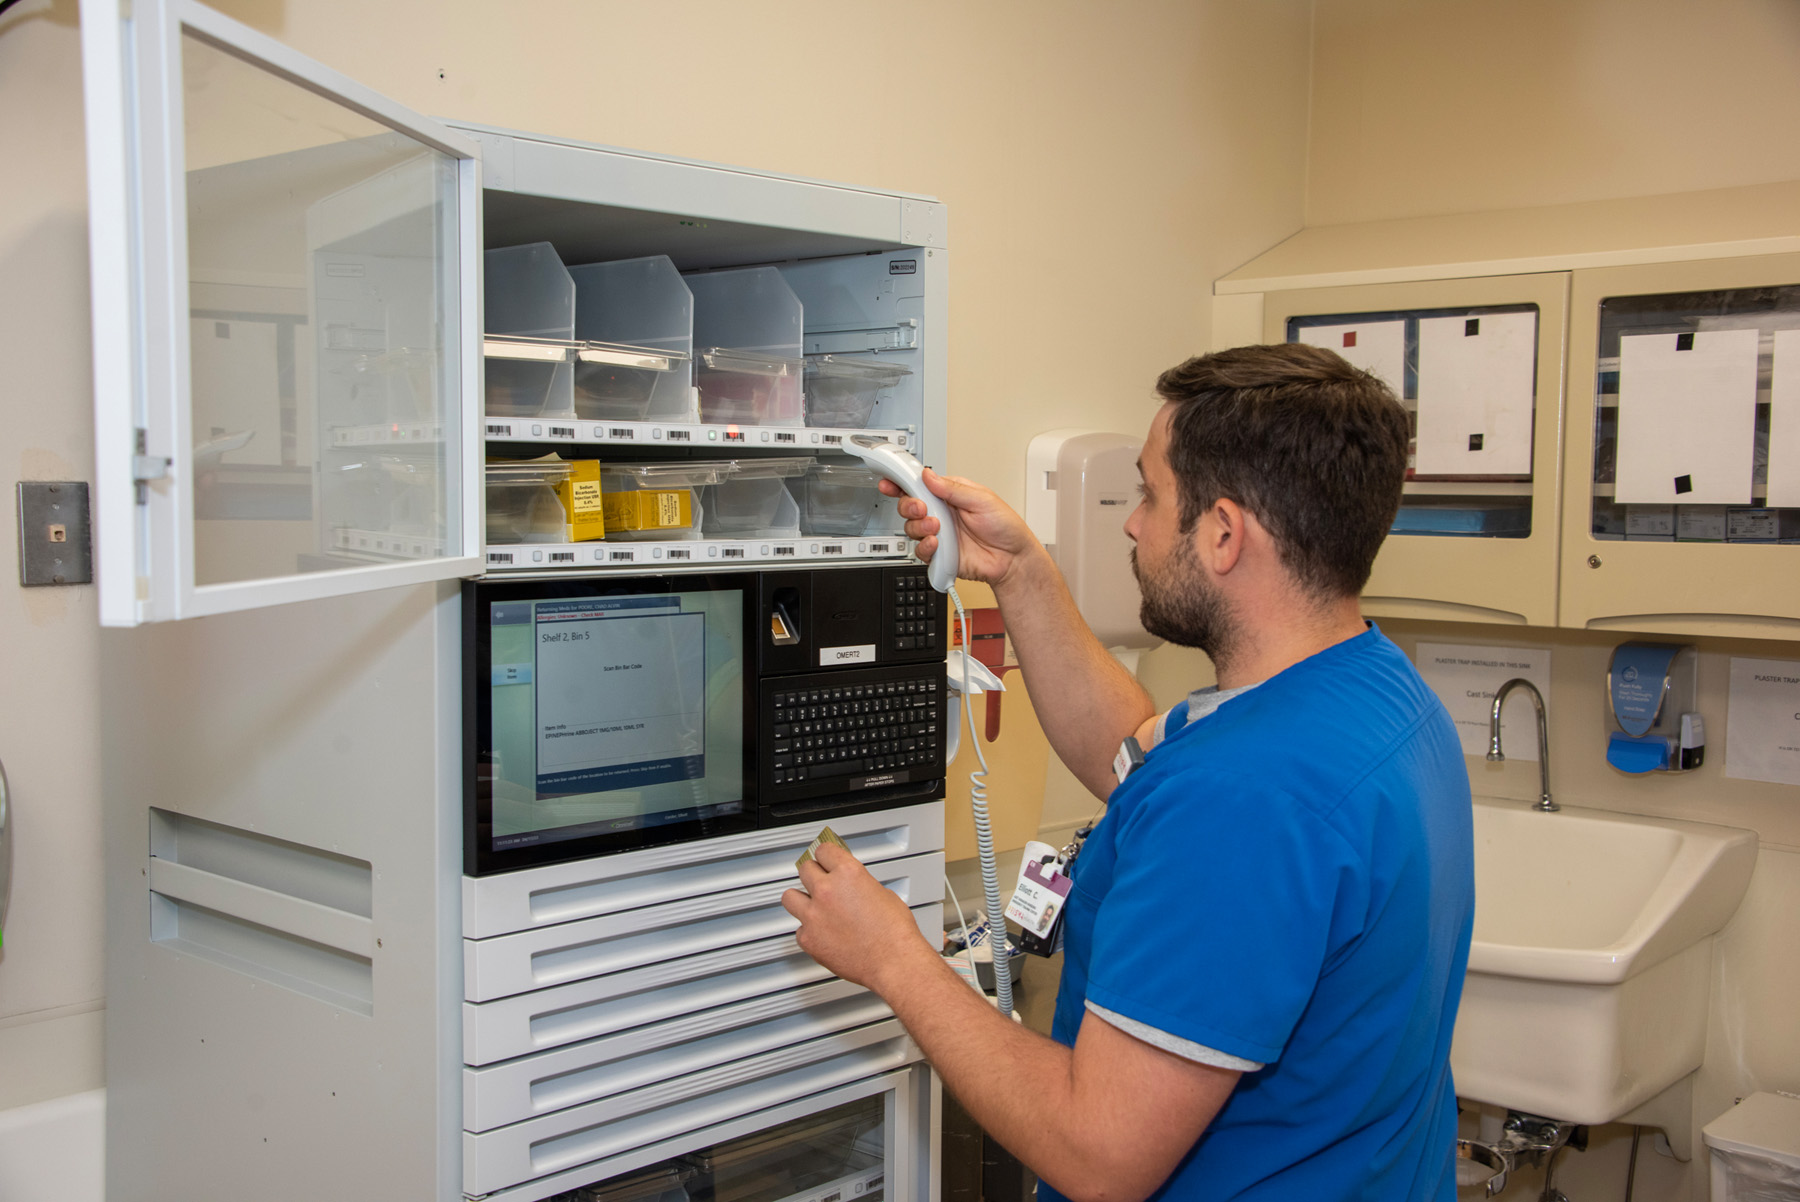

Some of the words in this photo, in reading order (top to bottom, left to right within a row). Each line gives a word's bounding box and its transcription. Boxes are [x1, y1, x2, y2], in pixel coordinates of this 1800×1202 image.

[542, 633, 562, 643] Shelf
[563, 633, 570, 642] 2,
[572, 632, 584, 641] Bin
[585, 632, 590, 640] 5
[836, 651, 860, 659] OMERT2
[1754, 674, 1781, 682] PLASTER
